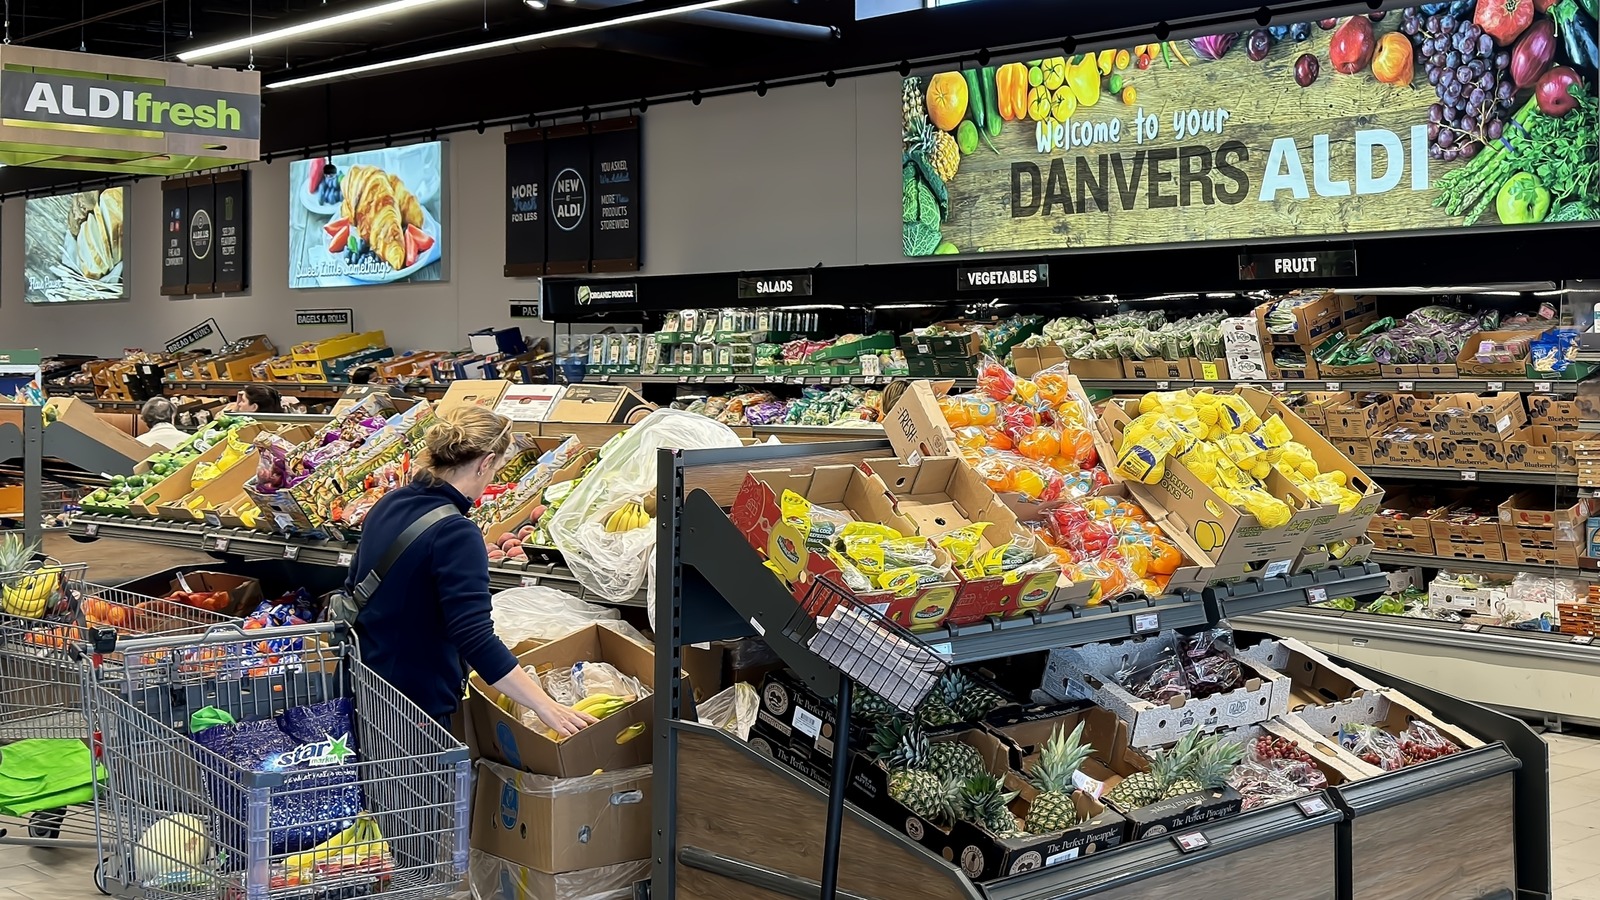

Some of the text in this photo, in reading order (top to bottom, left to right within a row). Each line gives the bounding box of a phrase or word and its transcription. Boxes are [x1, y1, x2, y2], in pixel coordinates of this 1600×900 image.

[24, 82, 240, 130] ALDIfresh
[1035, 107, 1230, 153] Welcome to your
[601, 162, 610, 172] YOU
[1010, 124, 1429, 218] DANVERS ALDI
[512, 183, 538, 199] MORE
[557, 178, 580, 193] NEW
[512, 212, 538, 222] FOR LESS
[557, 203, 581, 218] ALDI
[602, 206, 628, 217] PRODUCTS
[321, 261, 342, 277] Little
[344, 255, 392, 279] Somethings
[1274, 257, 1317, 274] FRUIT
[967, 269, 1037, 286] VEGETABLES
[590, 290, 634, 299] ORGANIC PRODUCE
[756, 279, 793, 294] SALADS
[297, 314, 346, 324] BAGELS & ROLLS
[522, 306, 538, 316] PAS
[168, 338, 189, 353] BREAD
[193, 326, 211, 339] BUNS
[898, 408, 918, 442] FRESH
[1160, 479, 1182, 500] ONS
[1164, 468, 1194, 499] ORNIA
[819, 527, 832, 535] COOL
[793, 691, 803, 703] The
[804, 698, 824, 717] Perfect
[1228, 700, 1248, 715] GRAPES
[1036, 711, 1055, 719] Perfect
[277, 742, 331, 766] star
[311, 755, 337, 764] market
[777, 748, 788, 761] The
[789, 756, 810, 774] Perfect
[1172, 804, 1236, 828] The Perfect Pineapple
[1047, 828, 1118, 854] The Perfect Pineapple
